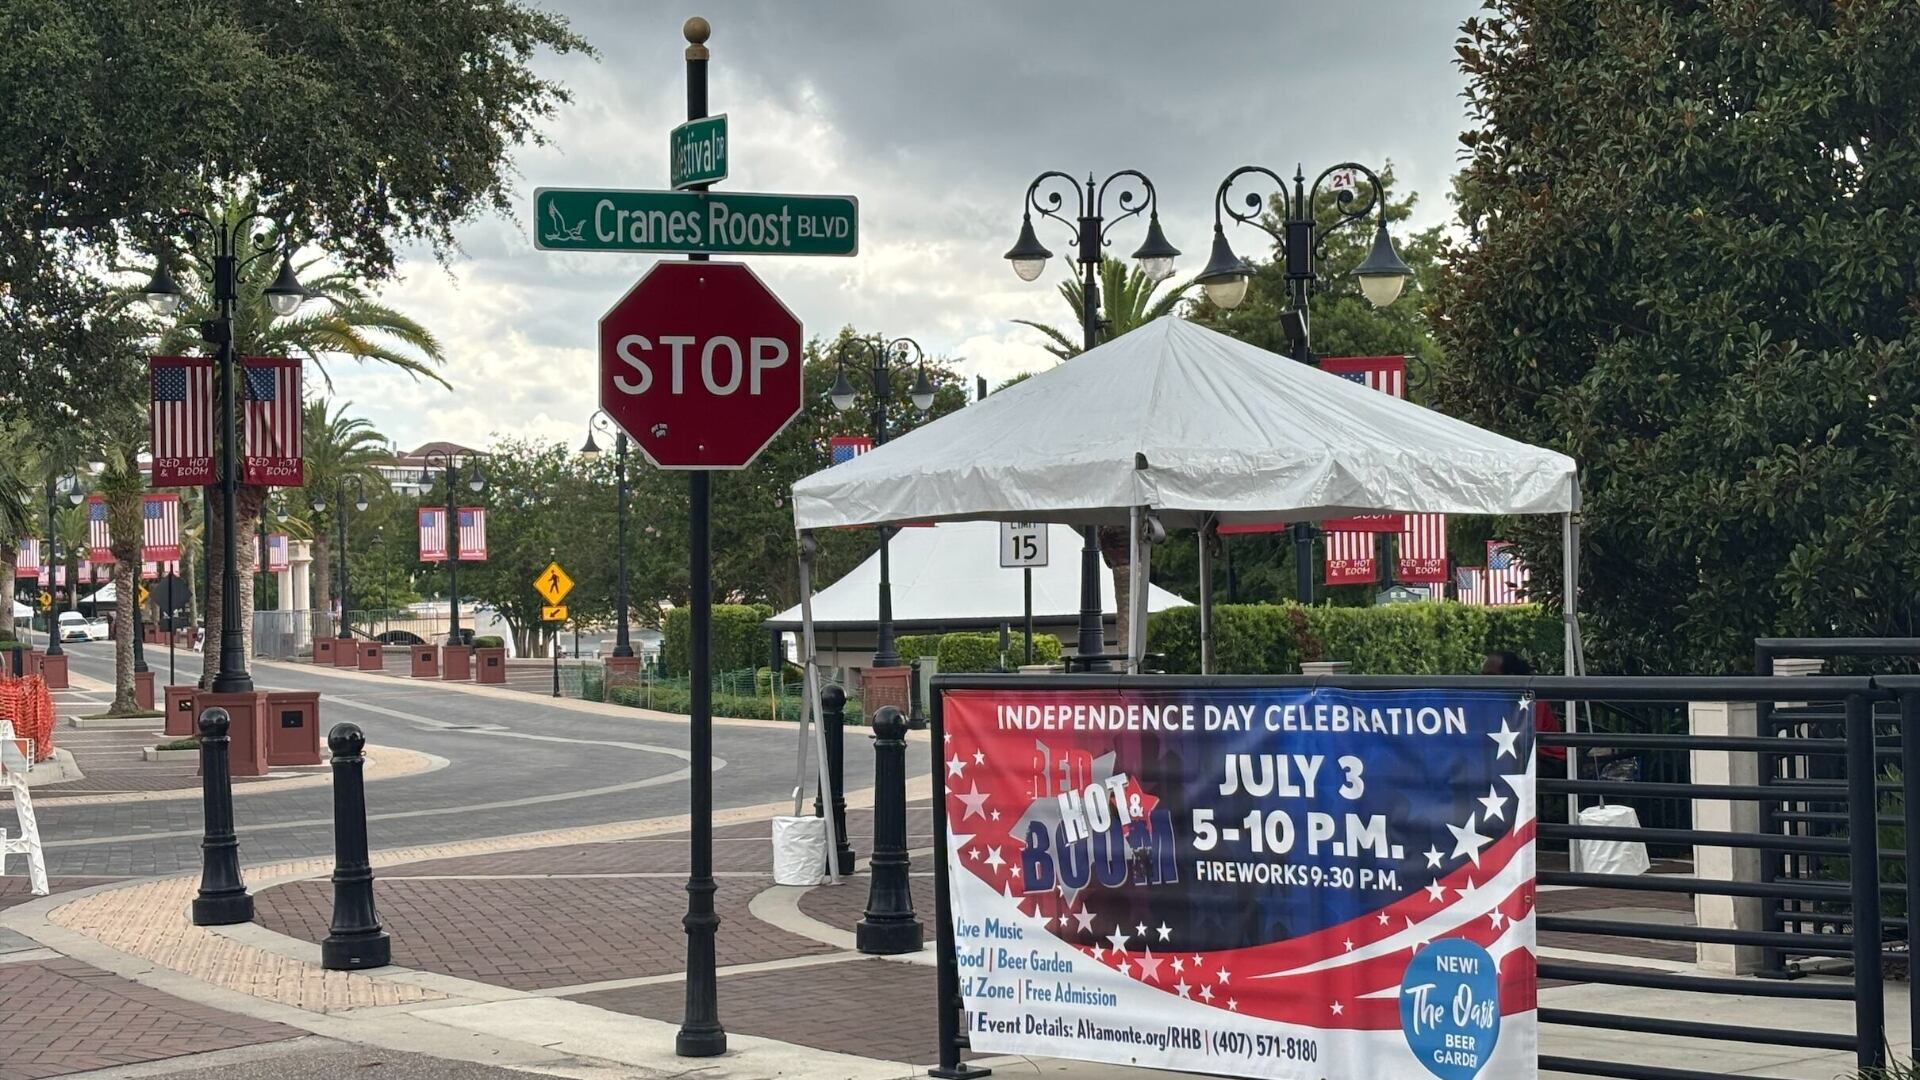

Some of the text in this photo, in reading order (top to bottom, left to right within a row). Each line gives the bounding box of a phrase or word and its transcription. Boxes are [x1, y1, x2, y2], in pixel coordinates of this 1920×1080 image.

[1333, 172, 1351, 188] 21
[594, 198, 849, 247] Cranes Roost BLVD
[613, 334, 790, 396] STOP
[159, 457, 209, 468] RED HOT
[160, 467, 209, 477] & BOOM
[248, 457, 298, 467] RED HOT
[249, 467, 298, 476] & BOOM
[1012, 535, 1038, 560] 15
[1330, 559, 1371, 569] RED HOT
[1345, 567, 1371, 576] BOOM
[1400, 559, 1441, 567] RED HOT
[1415, 567, 1441, 575] BOOM
[997, 704, 1467, 735] INDEPENDENCE DAY CELEBRATION
[1028, 747, 1093, 800] RED
[1218, 753, 1365, 800] JULY 3
[1058, 772, 1144, 844] HOT &
[1192, 808, 1405, 860] 5-10 P.M.
[1021, 810, 1179, 894] BOOM
[1196, 860, 1403, 892] FIREWORKS 9:30 P.M.
[956, 916, 1024, 940] Live Music
[956, 946, 1073, 973] Food Beer Garden
[1436, 955, 1479, 975] NEW!
[976, 976, 1015, 999] Zone
[1025, 979, 1052, 1001] Free
[1054, 981, 1117, 1008] Admission
[1405, 983, 1445, 1035] The
[978, 1011, 1022, 1034] Event
[1025, 1013, 1074, 1038] Details:
[1077, 1017, 1202, 1051] Altamonte.org/RHB
[1213, 1030, 1253, 1059] (407)
[1256, 1034, 1318, 1063] 571-8180
[1445, 1033, 1476, 1051] BEER
